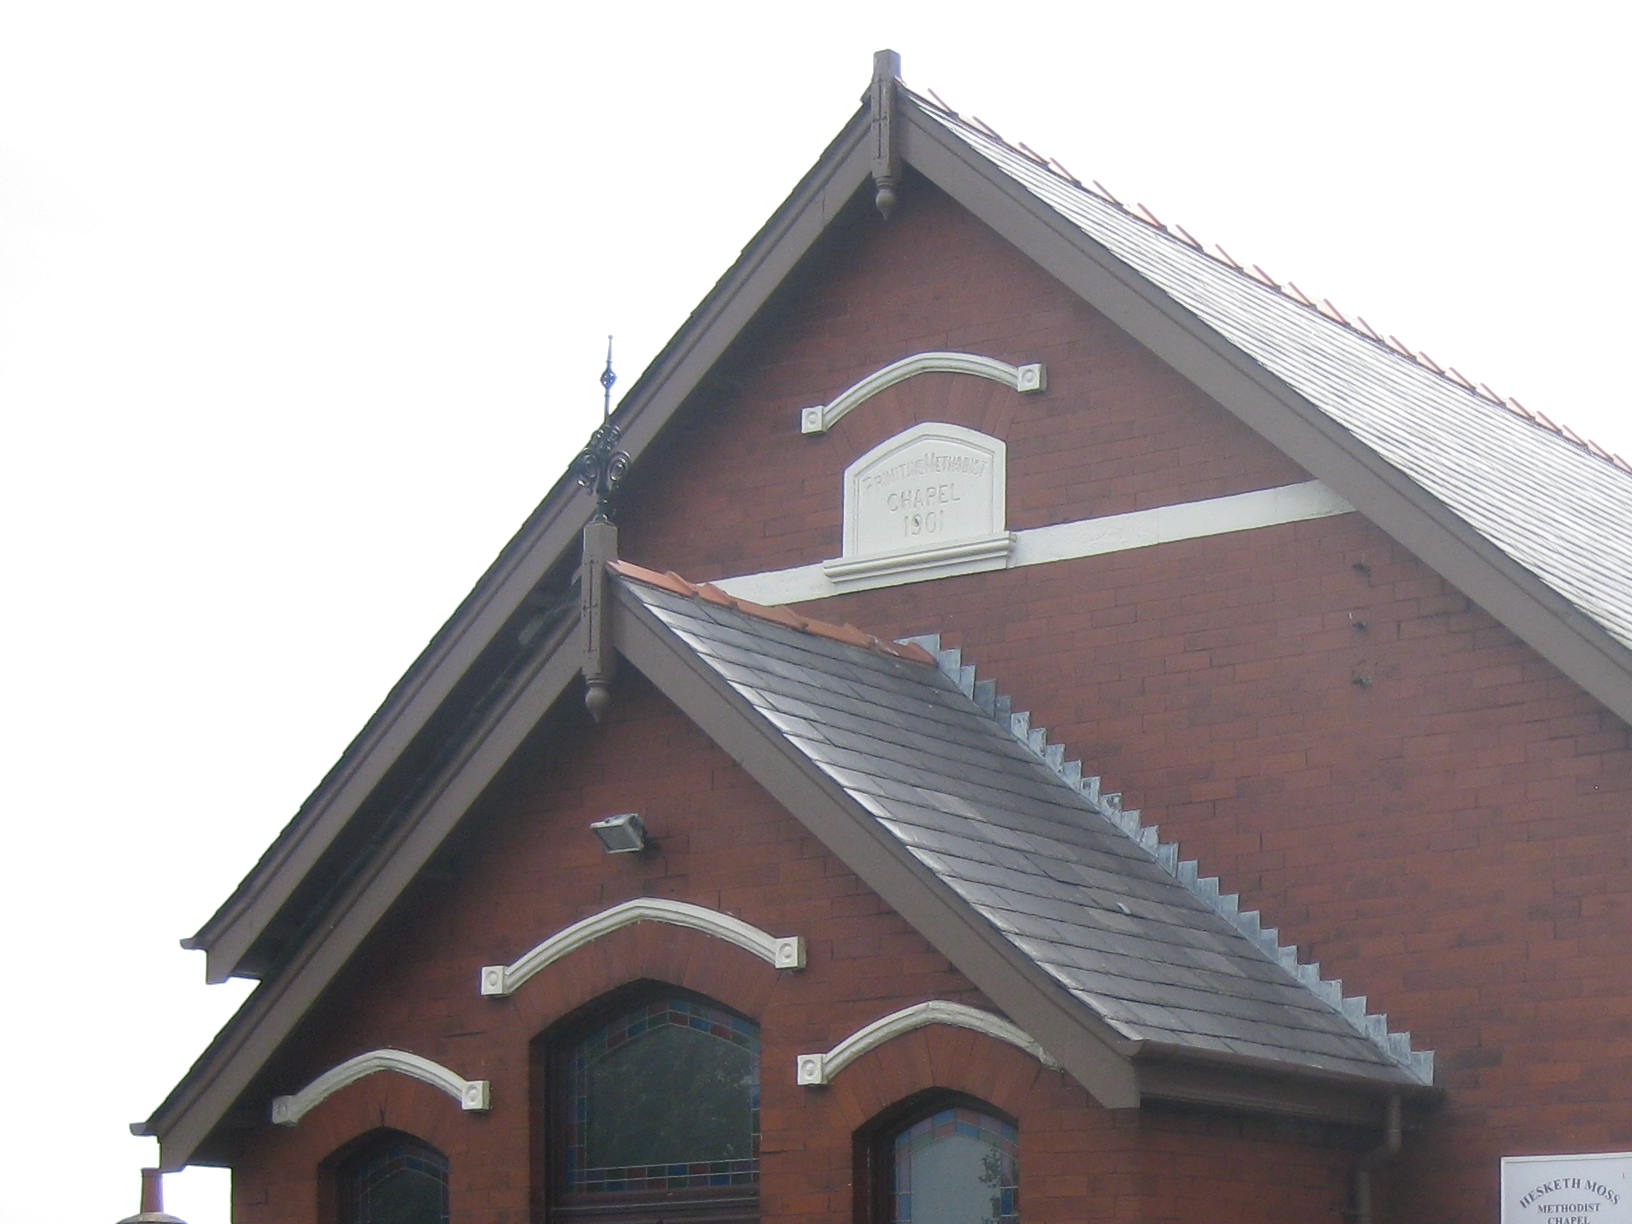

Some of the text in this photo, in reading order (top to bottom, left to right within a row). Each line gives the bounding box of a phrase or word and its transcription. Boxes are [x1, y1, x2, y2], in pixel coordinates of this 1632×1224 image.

[886, 483, 961, 512] CHAPEL
[903, 510, 944, 537] 1901
[1519, 1178, 1620, 1208] HESKETH MOSS
[1538, 1203, 1600, 1214] METHODIST
